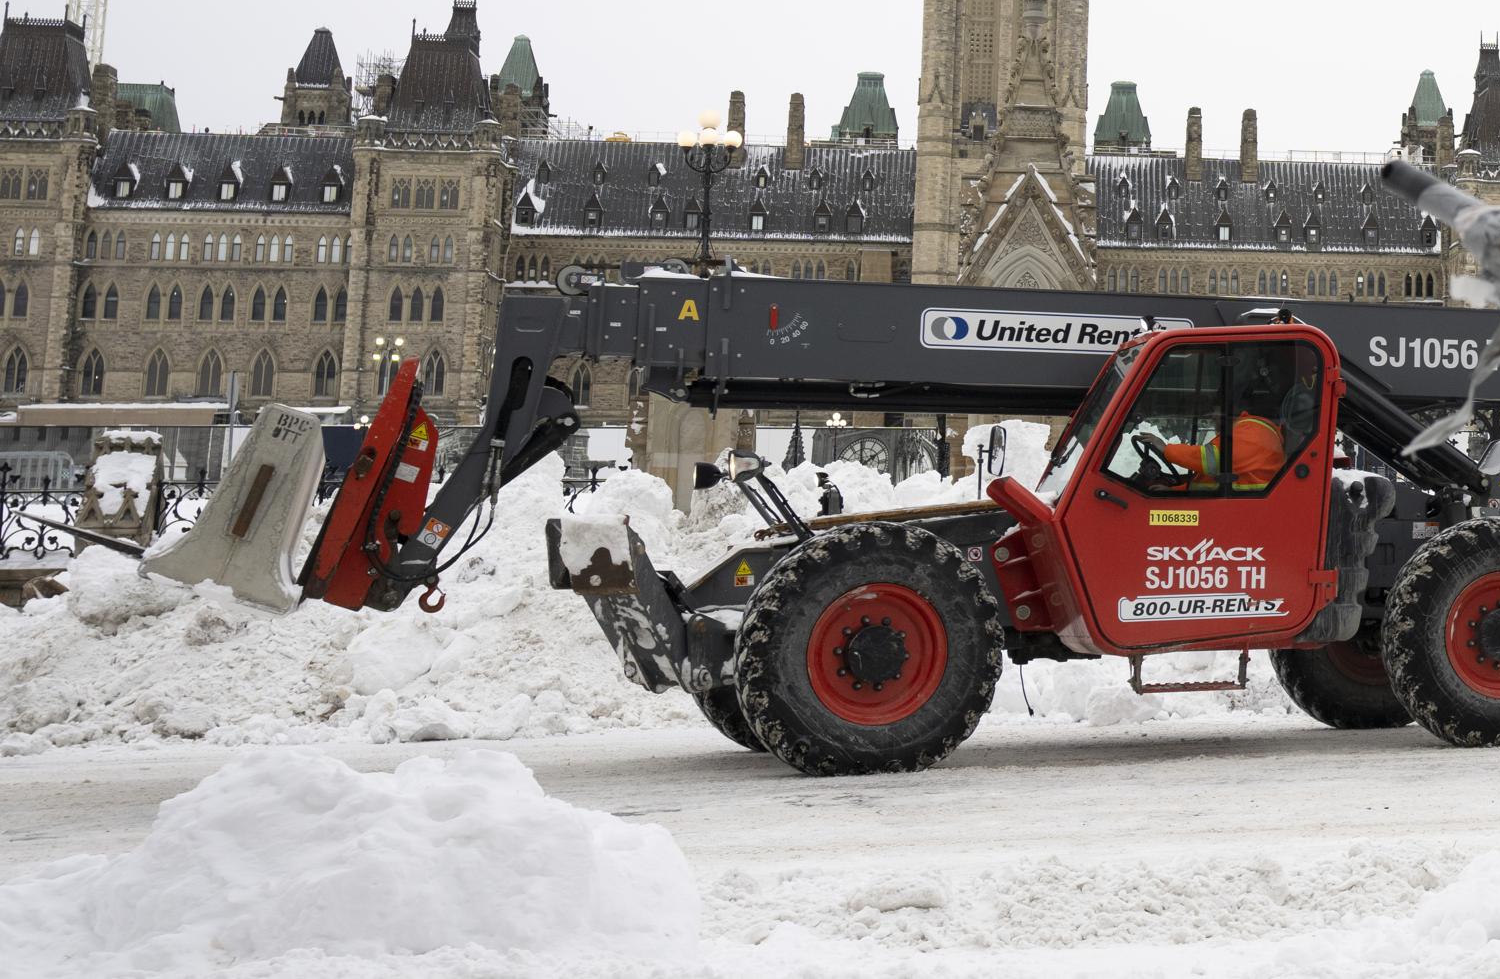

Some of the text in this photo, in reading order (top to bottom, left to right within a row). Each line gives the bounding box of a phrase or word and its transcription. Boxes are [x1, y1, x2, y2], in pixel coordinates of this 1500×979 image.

[677, 299, 700, 320] A
[780, 335, 791, 344] 20
[792, 329, 801, 339] 40
[975, 318, 1167, 345] United Rent
[1369, 336, 1478, 369] SJ1056
[1150, 513, 1198, 523] 11068339
[1146, 538, 1265, 564] SKYJACK
[1145, 566, 1266, 589] SJ1056 TH
